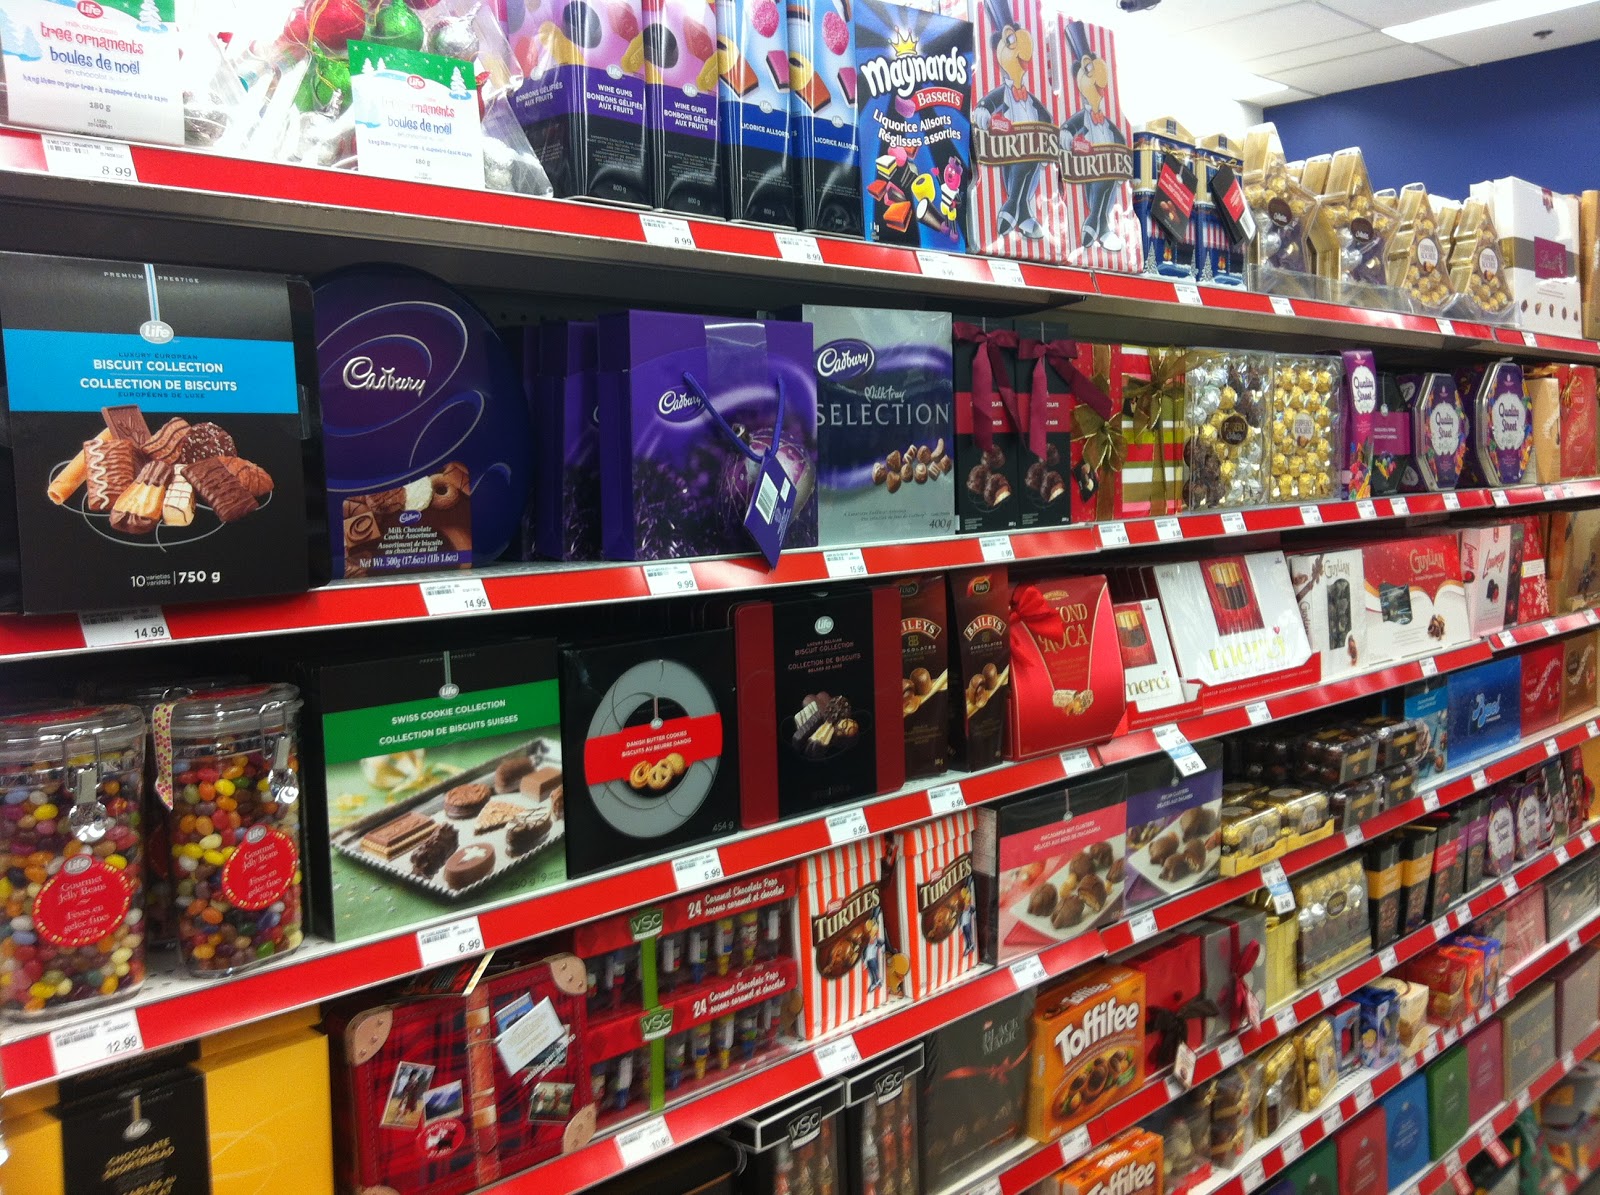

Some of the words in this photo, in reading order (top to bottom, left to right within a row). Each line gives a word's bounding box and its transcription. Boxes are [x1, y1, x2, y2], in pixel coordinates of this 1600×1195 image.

[80, 1, 102, 17] Life
[40, 22, 72, 39] tree
[76, 33, 143, 54] ornaments
[50, 47, 93, 67] boules
[96, 54, 111, 71] de
[114, 60, 140, 74] noël
[608, 65, 622, 77] Life
[515, 85, 545, 103] BONBONS
[597, 84, 614, 95] WINE
[615, 87, 633, 98] GUMS
[916, 90, 961, 107] Bassett's
[524, 98, 535, 108] AUX
[535, 92, 553, 105] FRUITS
[586, 92, 611, 106] BONBONS
[612, 96, 643, 111] GÉLIFIÉS
[674, 101, 689, 112] WINE
[691, 105, 707, 115] GUMS
[598, 102, 611, 111] AUX
[612, 104, 634, 116] FRUITS
[388, 117, 418, 131] boules
[420, 119, 431, 131] de
[434, 123, 452, 134] noël
[664, 110, 687, 123] BONBONS
[688, 113, 717, 127] GÉLIFIÉS
[675, 119, 687, 129] AUX
[688, 121, 708, 133] FRUITS
[873, 109, 918, 133] Liquorice
[920, 115, 951, 132] Allsorts
[741, 122, 766, 133] LICORICE
[815, 136, 837, 147] LICORICE
[878, 129, 922, 148] Réglisses
[923, 127, 961, 146] assorties
[974, 127, 1059, 159] TURTLES
[1060, 148, 1132, 178] TURTLES
[613, 184, 621, 193] 800
[103, 271, 144, 280] PREMIUM
[158, 275, 200, 284] PRESTIGE
[145, 325, 170, 338] Life
[118, 352, 151, 360] LUXURY
[154, 353, 199, 361] EUROPEAN
[817, 347, 871, 377] Cadbury
[93, 360, 143, 372] BISCUIT
[146, 361, 223, 374] COLLECTION
[80, 377, 162, 390] COLLECTION
[165, 379, 181, 391] DE
[184, 380, 238, 392] BISCUITS
[343, 356, 426, 397] Cadbury
[1354, 372, 1373, 390] Quality
[658, 389, 702, 415] Cadbury
[1357, 391, 1372, 403] Street
[816, 403, 949, 427] SELECTION
[1435, 411, 1453, 427] Quality
[1500, 402, 1519, 419] Quality
[1438, 427, 1452, 440] Street
[1502, 419, 1518, 433] Street
[378, 540, 413, 550] Assortiment
[422, 538, 443, 547] biscuits
[384, 533, 404, 541] Cookie
[406, 532, 438, 540] Assortment
[394, 547, 418, 555] chocolat
[359, 558, 372, 568] Net
[373, 557, 385, 568] Wt.
[386, 556, 401, 569] 500g
[402, 554, 427, 566] (17.6oz)
[441, 552, 459, 563] 1.6oz)
[131, 575, 146, 588] 10
[178, 571, 207, 584] 750
[211, 572, 221, 583] g
[464, 598, 487, 609] 14.99
[134, 626, 165, 640] 14.99
[817, 619, 832, 630] Life
[968, 617, 1002, 635] BAILEYS
[795, 646, 818, 656] BISCUIT
[819, 642, 854, 652] COLLECTION
[788, 659, 824, 671] COLLECTION
[826, 657, 834, 666] DE
[836, 653, 861, 663] BISCUITS
[441, 686, 456, 695] Life
[1126, 672, 1170, 697] merci
[392, 714, 419, 725] SWISS
[421, 708, 453, 720] COOKIE
[455, 699, 506, 714] COLLECTION
[379, 728, 434, 746] COLLECTION
[436, 725, 447, 736] DE
[449, 720, 485, 734] BISCUITS
[487, 714, 518, 727] SUISSES
[626, 738, 646, 748] DANISH
[646, 735, 665, 744] BUTTER
[666, 730, 687, 740] COOKIES
[622, 747, 645, 758] BISCUITS
[653, 741, 673, 752] BEURRE
[248, 828, 264, 840] Life
[712, 822, 727, 833] 454
[245, 843, 275, 860] Gourmet
[67, 858, 87, 873] Life
[242, 859, 257, 874] Jelly
[258, 850, 278, 864] Beans
[704, 868, 721, 880] 5.99
[60, 876, 103, 892] Gourmet
[920, 857, 972, 910] TURTLES
[59, 890, 79, 905] Jelly
[82, 883, 107, 899] Beans
[688, 902, 702, 919] 24
[705, 890, 732, 905] Caramel
[734, 881, 763, 896] Chocolate
[763, 877, 778, 889] Pops
[727, 896, 752, 910] caramel
[761, 885, 785, 898] chocolat
[632, 912, 661, 931] VSC
[814, 887, 880, 943] TURTLES
[64, 920, 87, 935] gelée
[89, 913, 110, 925] fines
[458, 938, 481, 953] 6.99
[693, 1000, 707, 1018] 24
[709, 986, 735, 1001] Caramel
[736, 976, 765, 992] Chocolate
[765, 971, 779, 983] Pops
[731, 990, 754, 1006] caramel
[762, 979, 785, 994] chocolat
[643, 1012, 671, 1032] VSC
[1055, 997, 1140, 1066] Toffifee
[106, 1035, 138, 1054] 12.99
[875, 1071, 902, 1095] VSC
[789, 1112, 820, 1137] VSC
